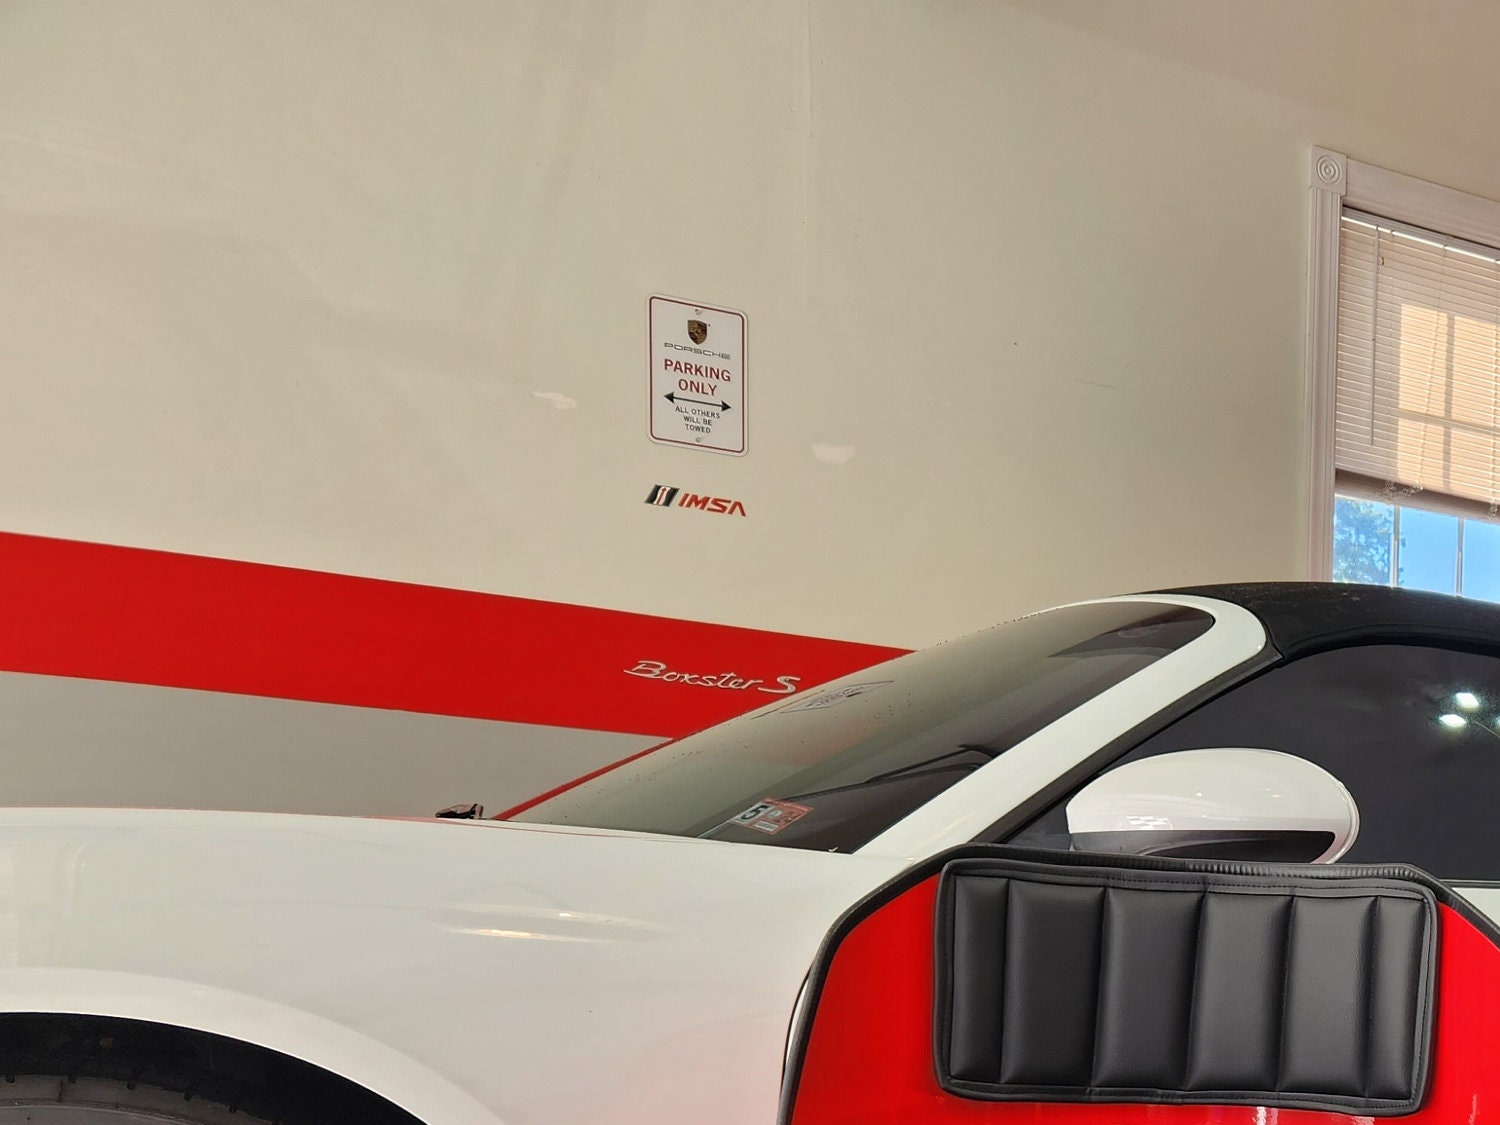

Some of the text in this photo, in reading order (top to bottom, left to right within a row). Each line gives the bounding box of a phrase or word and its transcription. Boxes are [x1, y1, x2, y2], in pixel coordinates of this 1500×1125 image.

[664, 342, 730, 360] PORSCHE
[664, 358, 731, 382] PARKING
[678, 379, 717, 396] ONLY
[675, 405, 720, 419] ALL OTHERS
[683, 415, 712, 427] WILL BE
[685, 423, 711, 434] TOWED
[678, 492, 746, 517] IMSA
[624, 660, 800, 695] Boxster S
